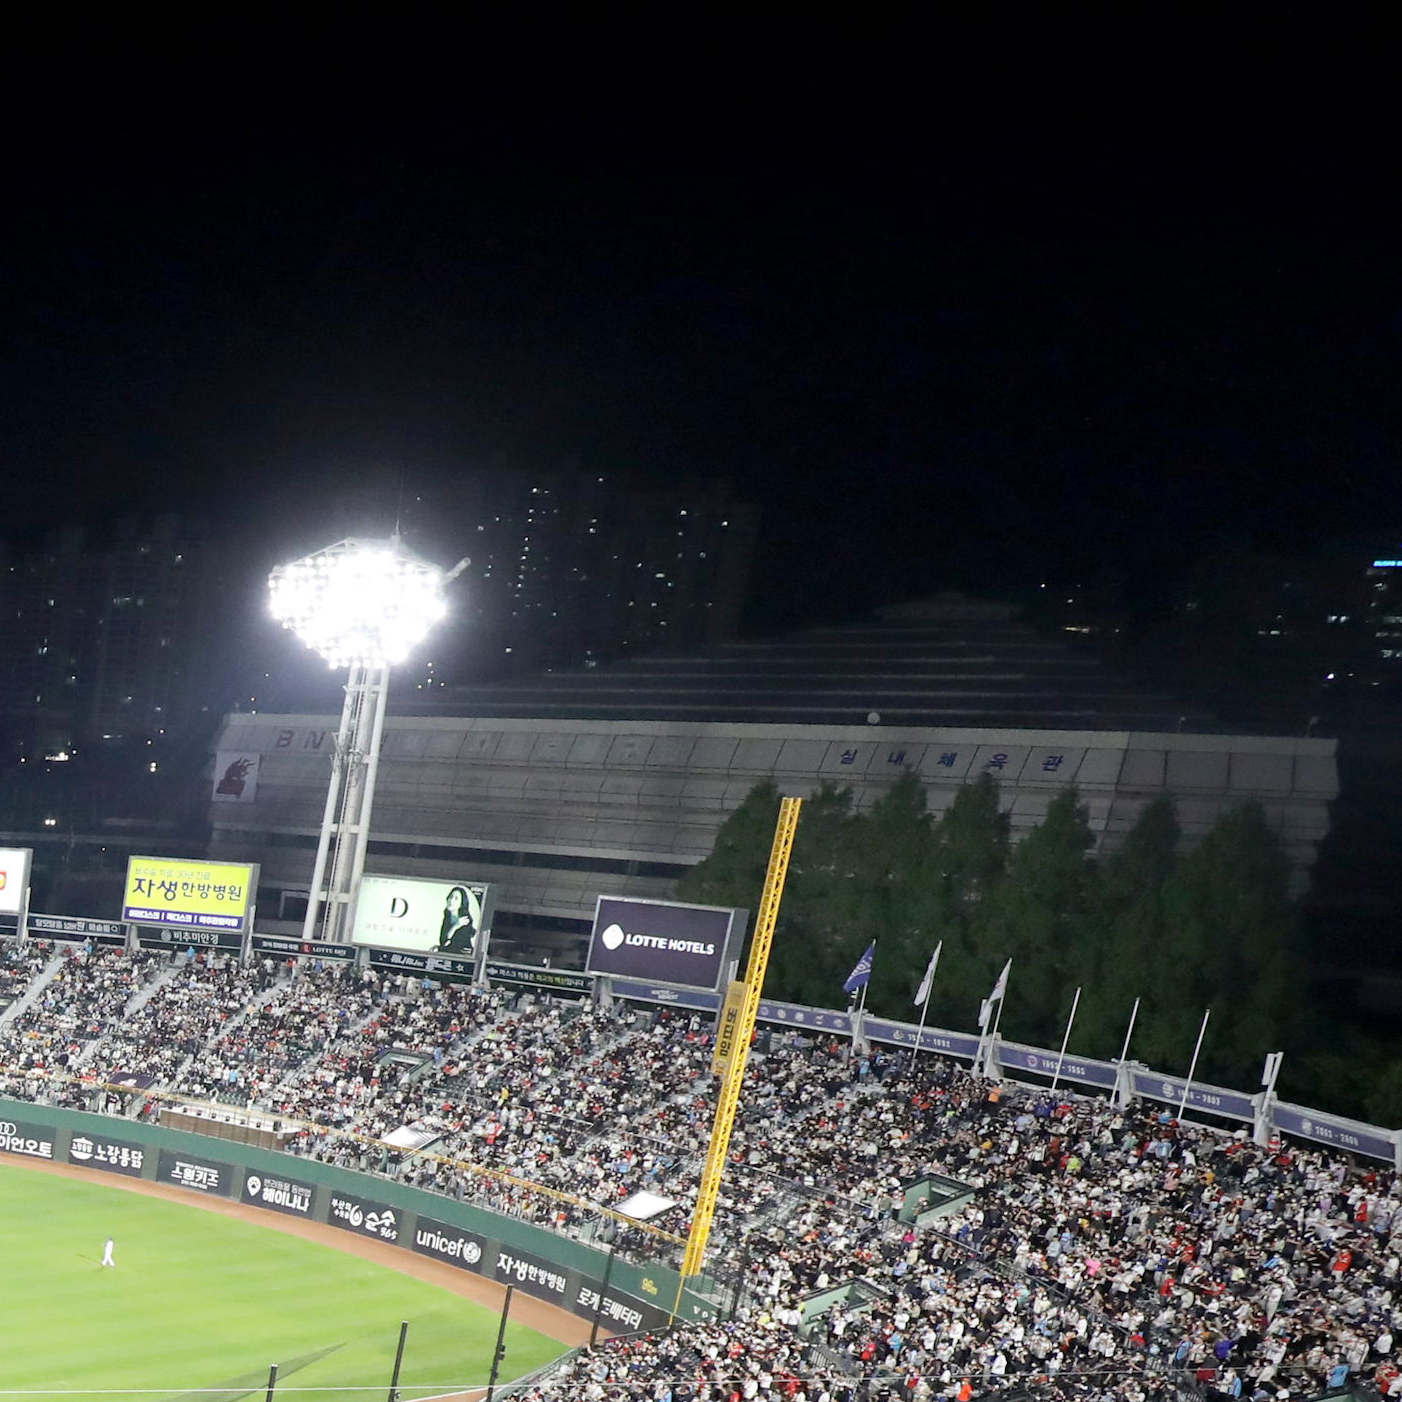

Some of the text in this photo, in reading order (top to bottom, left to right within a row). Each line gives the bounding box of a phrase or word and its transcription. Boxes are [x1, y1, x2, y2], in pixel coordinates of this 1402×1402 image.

[173, 931, 219, 944] 비추미안경
[626, 933, 715, 956] LOTTE HOTELS
[95, 1144, 144, 1170] 노랑통닭
[262, 1188, 310, 1213] 헤이나나
[417, 1229, 464, 1258] unicef
[497, 1252, 567, 1294] 자생한방병원
